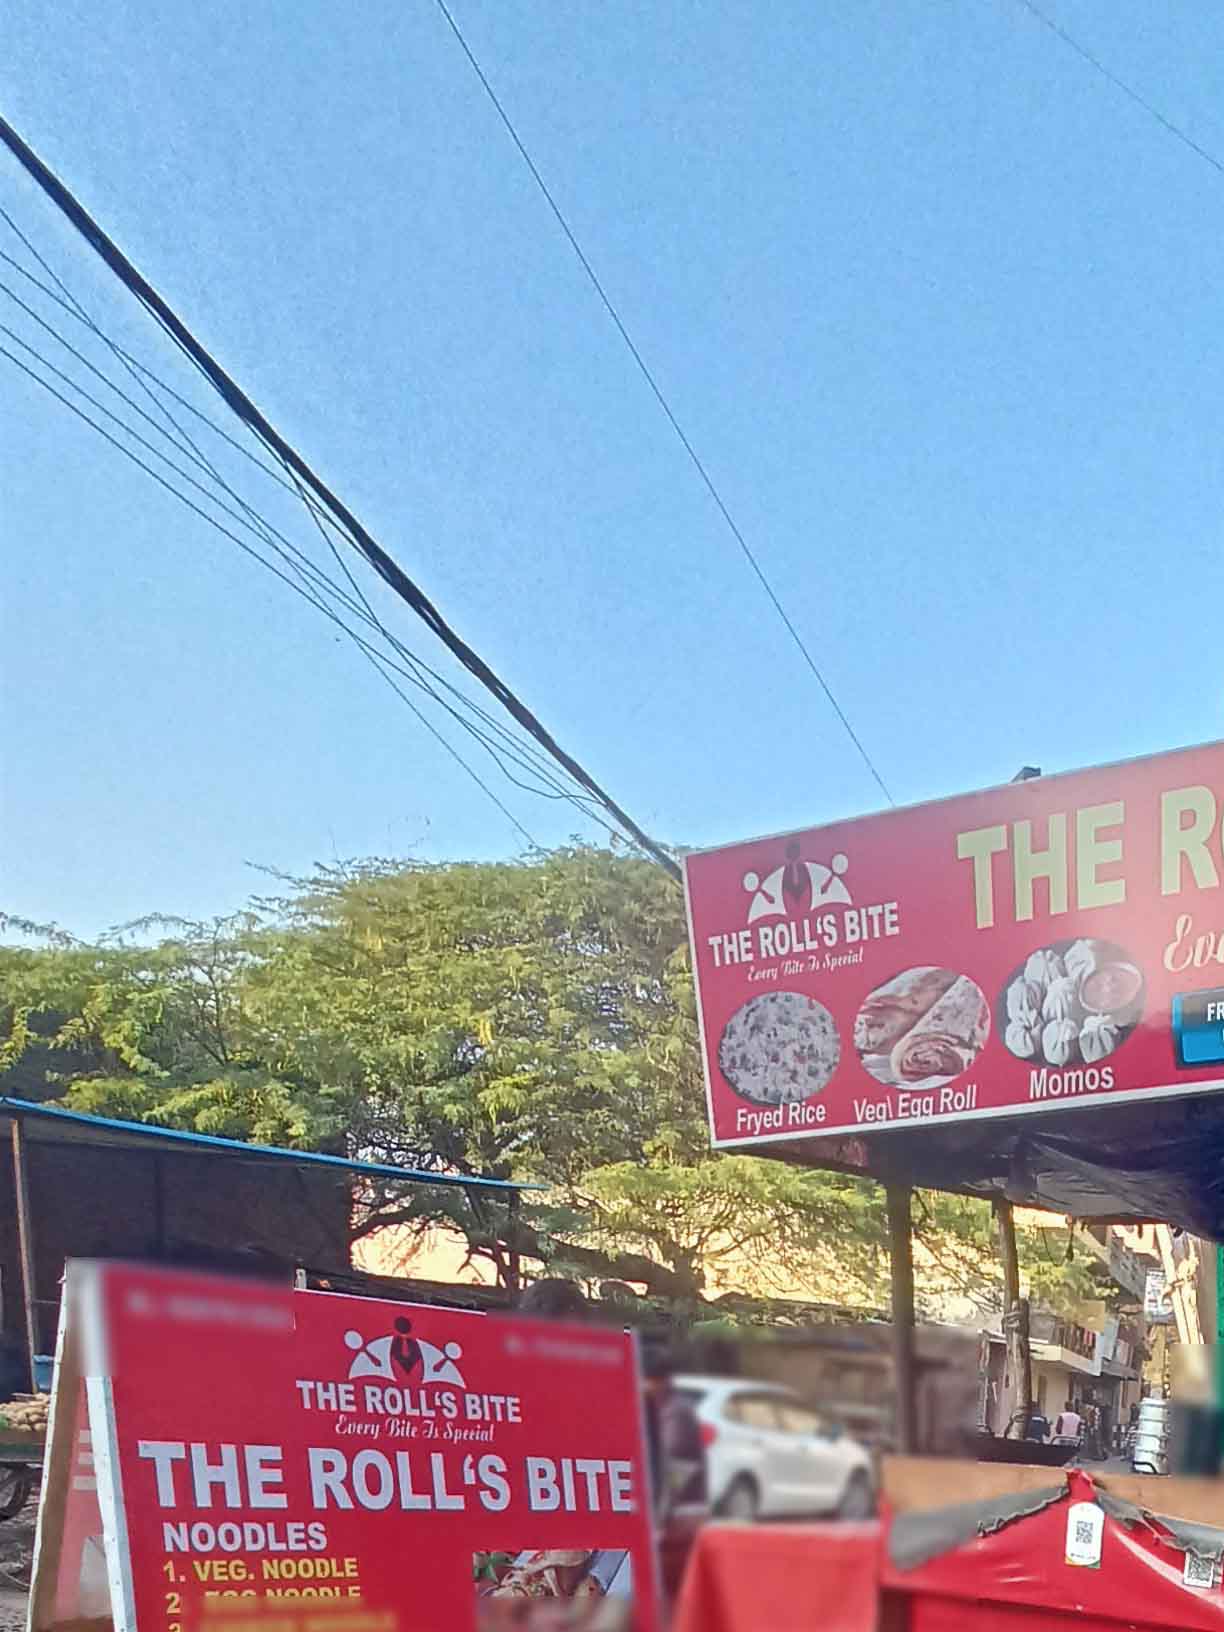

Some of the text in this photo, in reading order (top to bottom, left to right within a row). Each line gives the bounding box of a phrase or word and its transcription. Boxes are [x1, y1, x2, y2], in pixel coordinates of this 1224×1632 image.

[956, 800, 1127, 930] THE
[708, 902, 900, 967] THE ROLL'S BITE
[748, 966, 778, 982] Every
[781, 960, 804, 977] Bite
[822, 947, 864, 971] Special
[1030, 1066, 1114, 1100] Momos
[898, 1092, 933, 1116] Egg
[940, 1085, 977, 1112] Roll
[736, 1101, 826, 1135] Fryed Rice
[296, 1380, 522, 1423] THE ROLL'S BITE
[336, 1415, 381, 1441] Every
[385, 1416, 418, 1438] Bite
[443, 1421, 495, 1444] Special
[138, 1440, 633, 1512] THE ROLL'S BITE
[162, 1522, 328, 1552] NOODLES
[193, 1560, 256, 1582] VEG.
[262, 1558, 359, 1580] NOODLE
